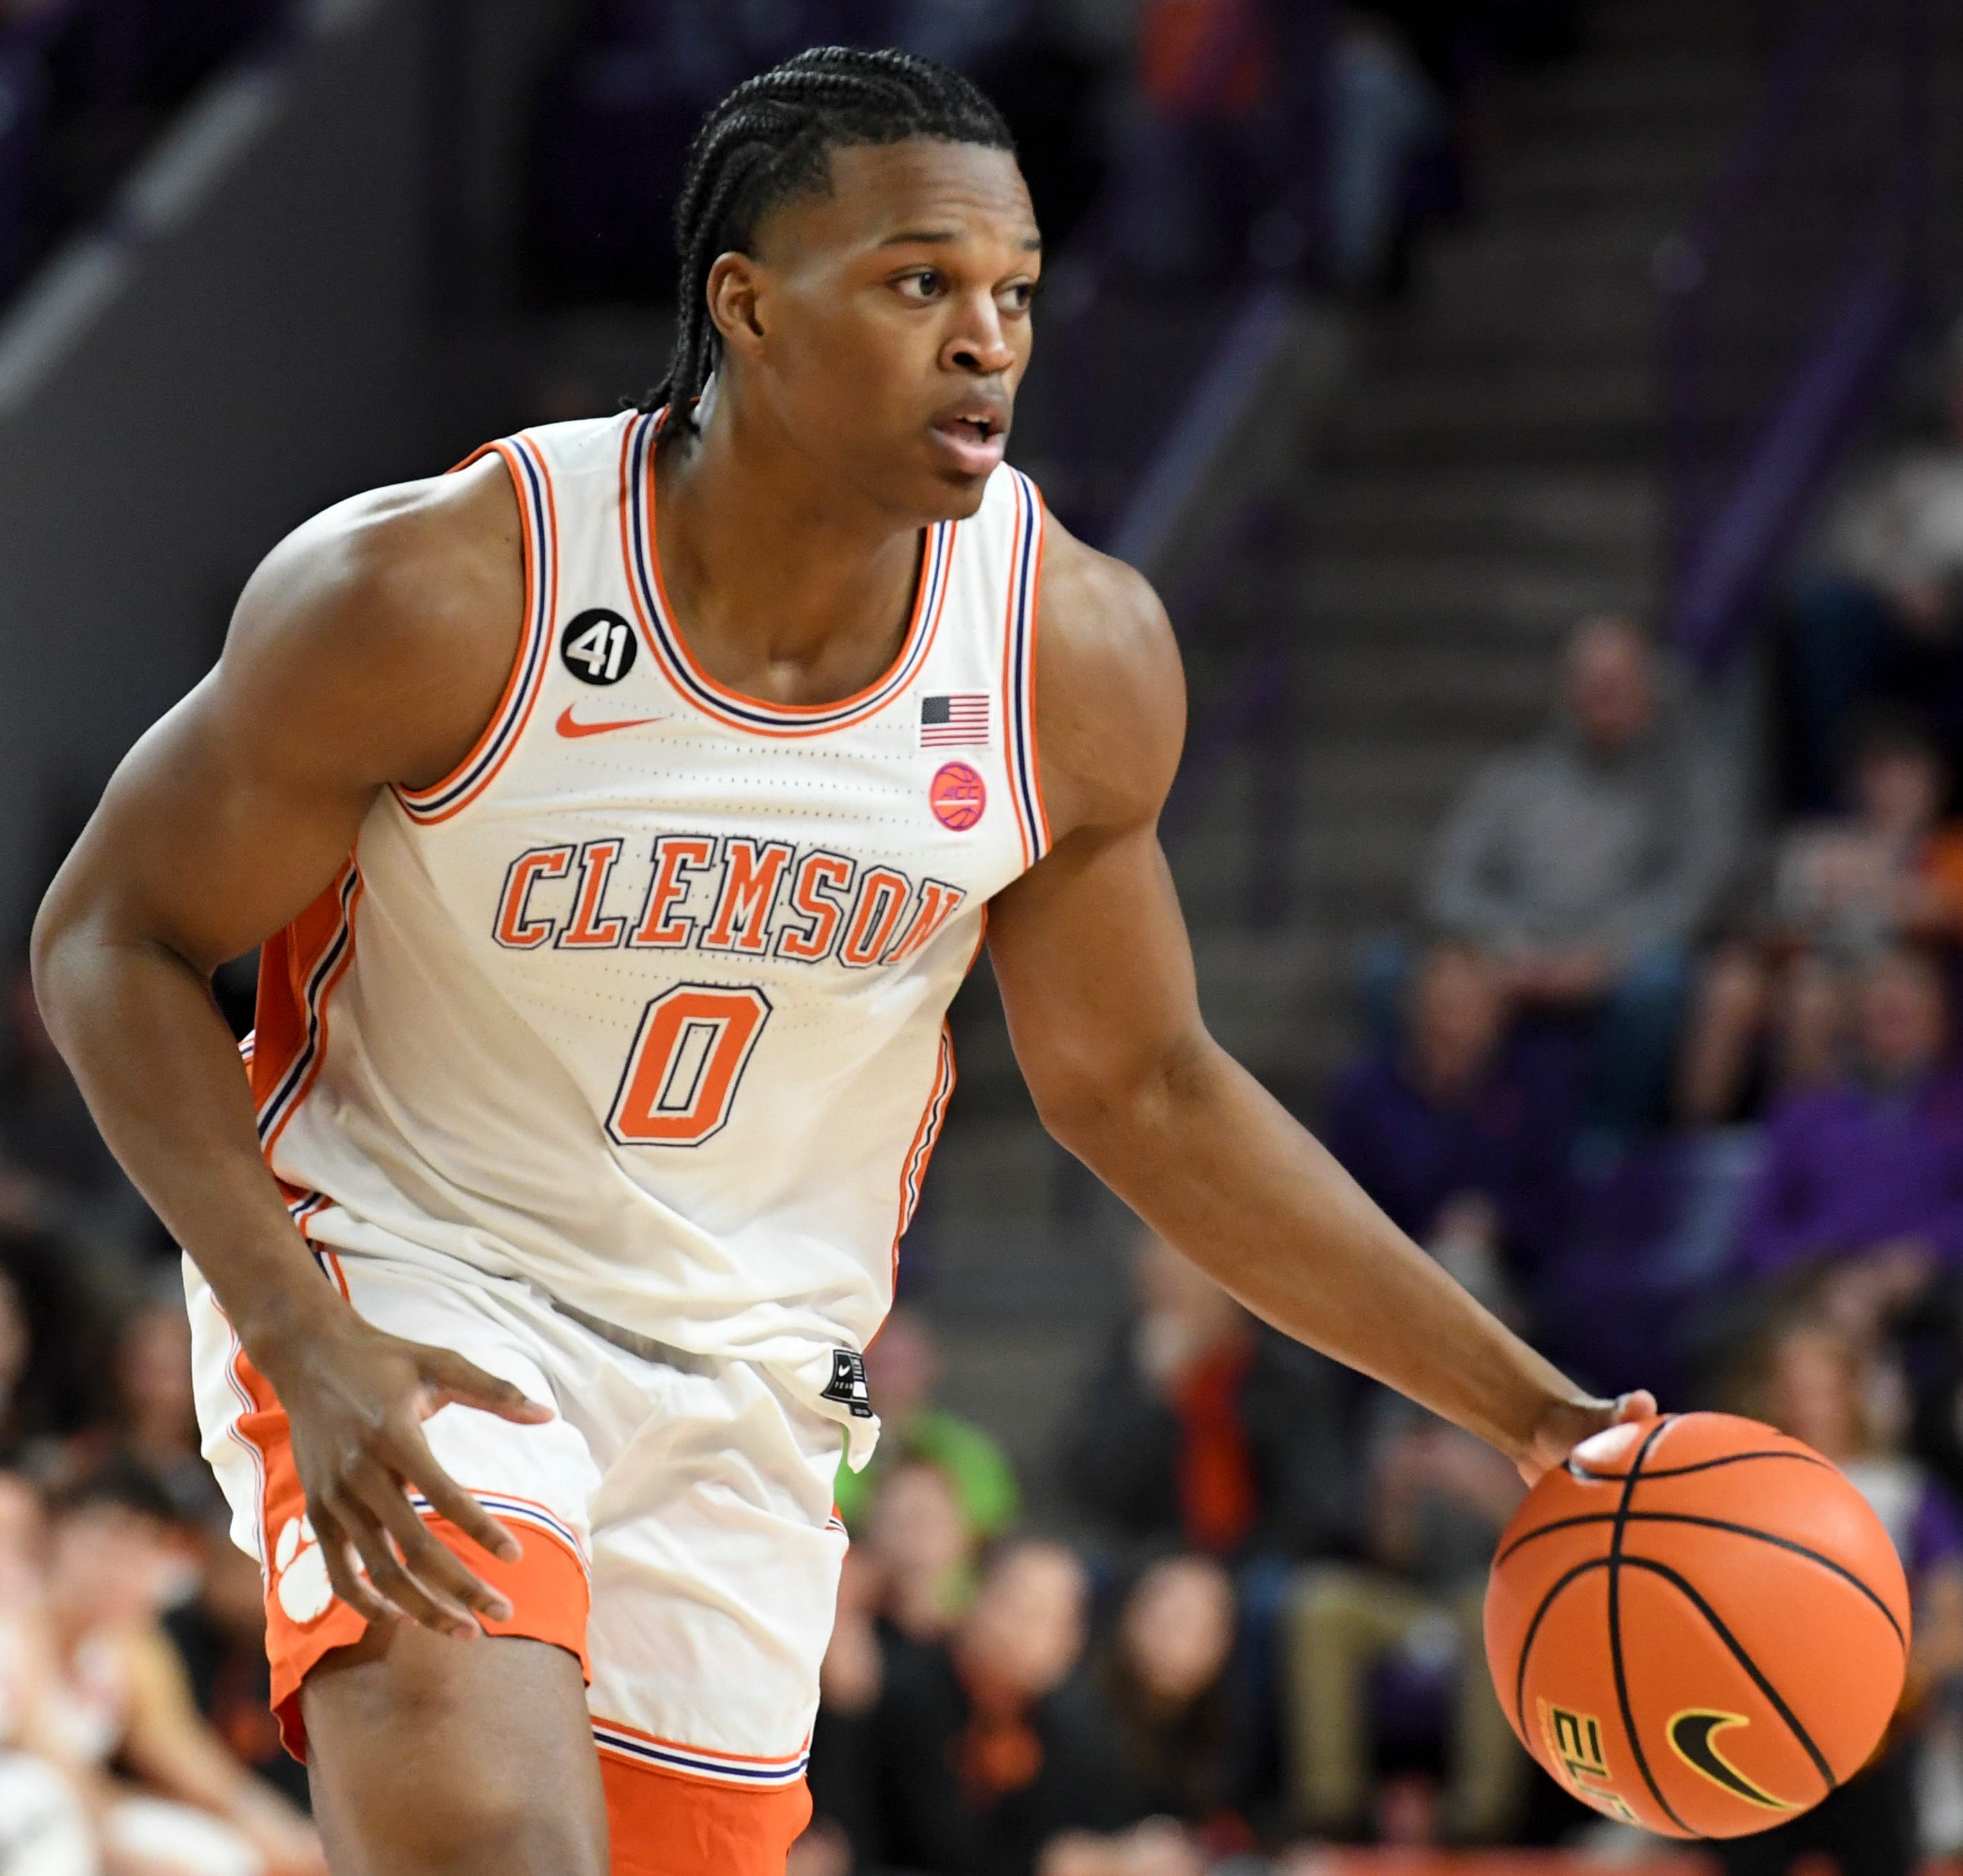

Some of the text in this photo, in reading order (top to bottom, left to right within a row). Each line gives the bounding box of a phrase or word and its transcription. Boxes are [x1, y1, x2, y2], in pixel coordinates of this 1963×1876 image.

[566, 619, 628, 680] 41
[491, 835, 967, 968] CLEMSON
[604, 982, 774, 1147] 0
